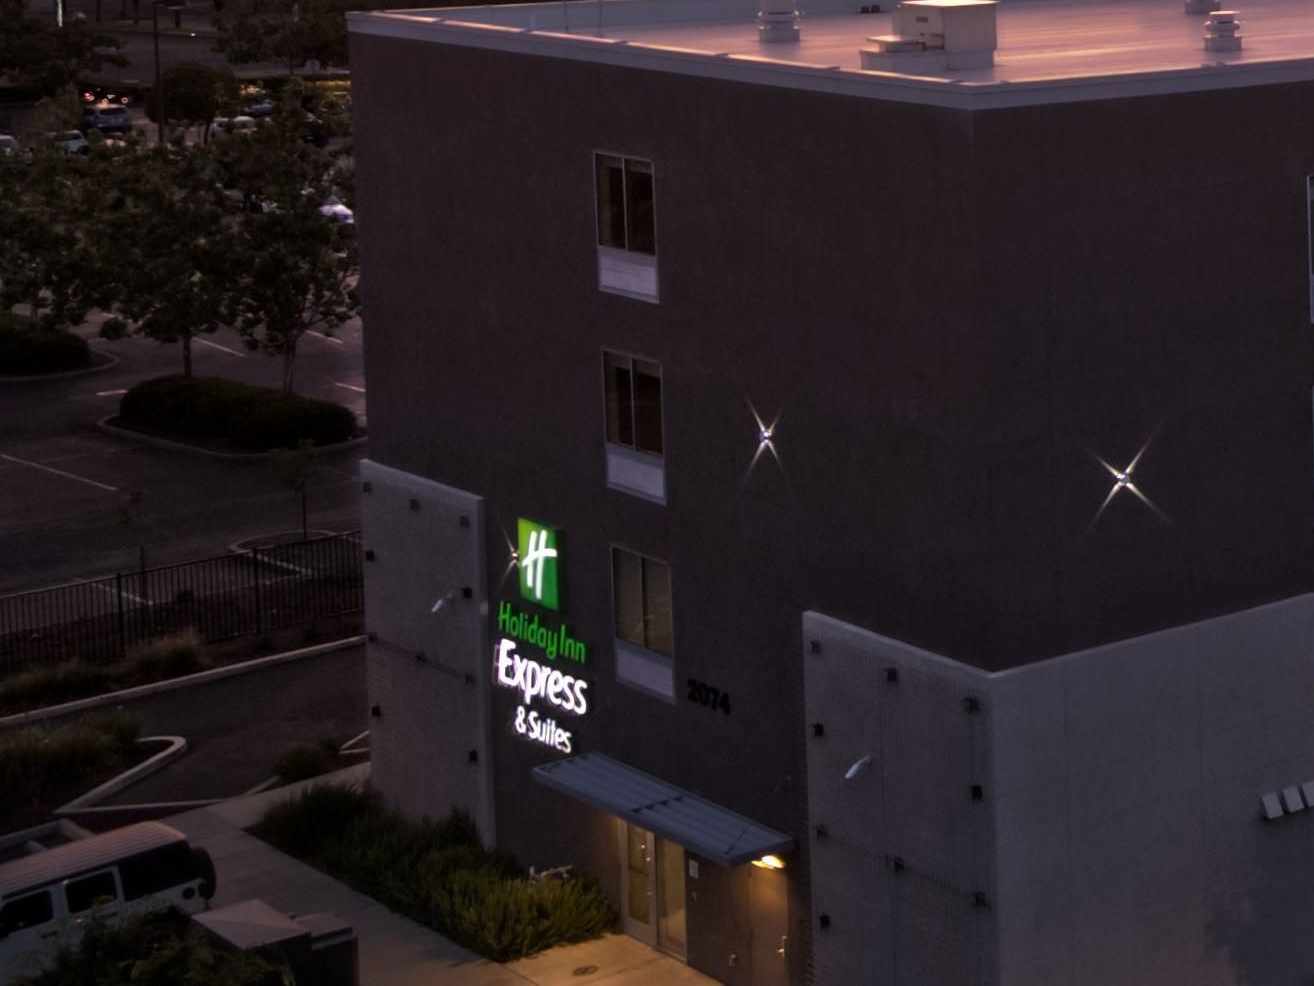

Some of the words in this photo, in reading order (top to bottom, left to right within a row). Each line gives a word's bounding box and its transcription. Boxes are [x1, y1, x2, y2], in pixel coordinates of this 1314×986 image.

[498, 601, 558, 660] Holiday
[559, 623, 587, 664] Inn
[497, 638, 588, 715] Express
[687, 678, 731, 716] 2074
[514, 705, 527, 734] &
[527, 710, 573, 754] Suites
